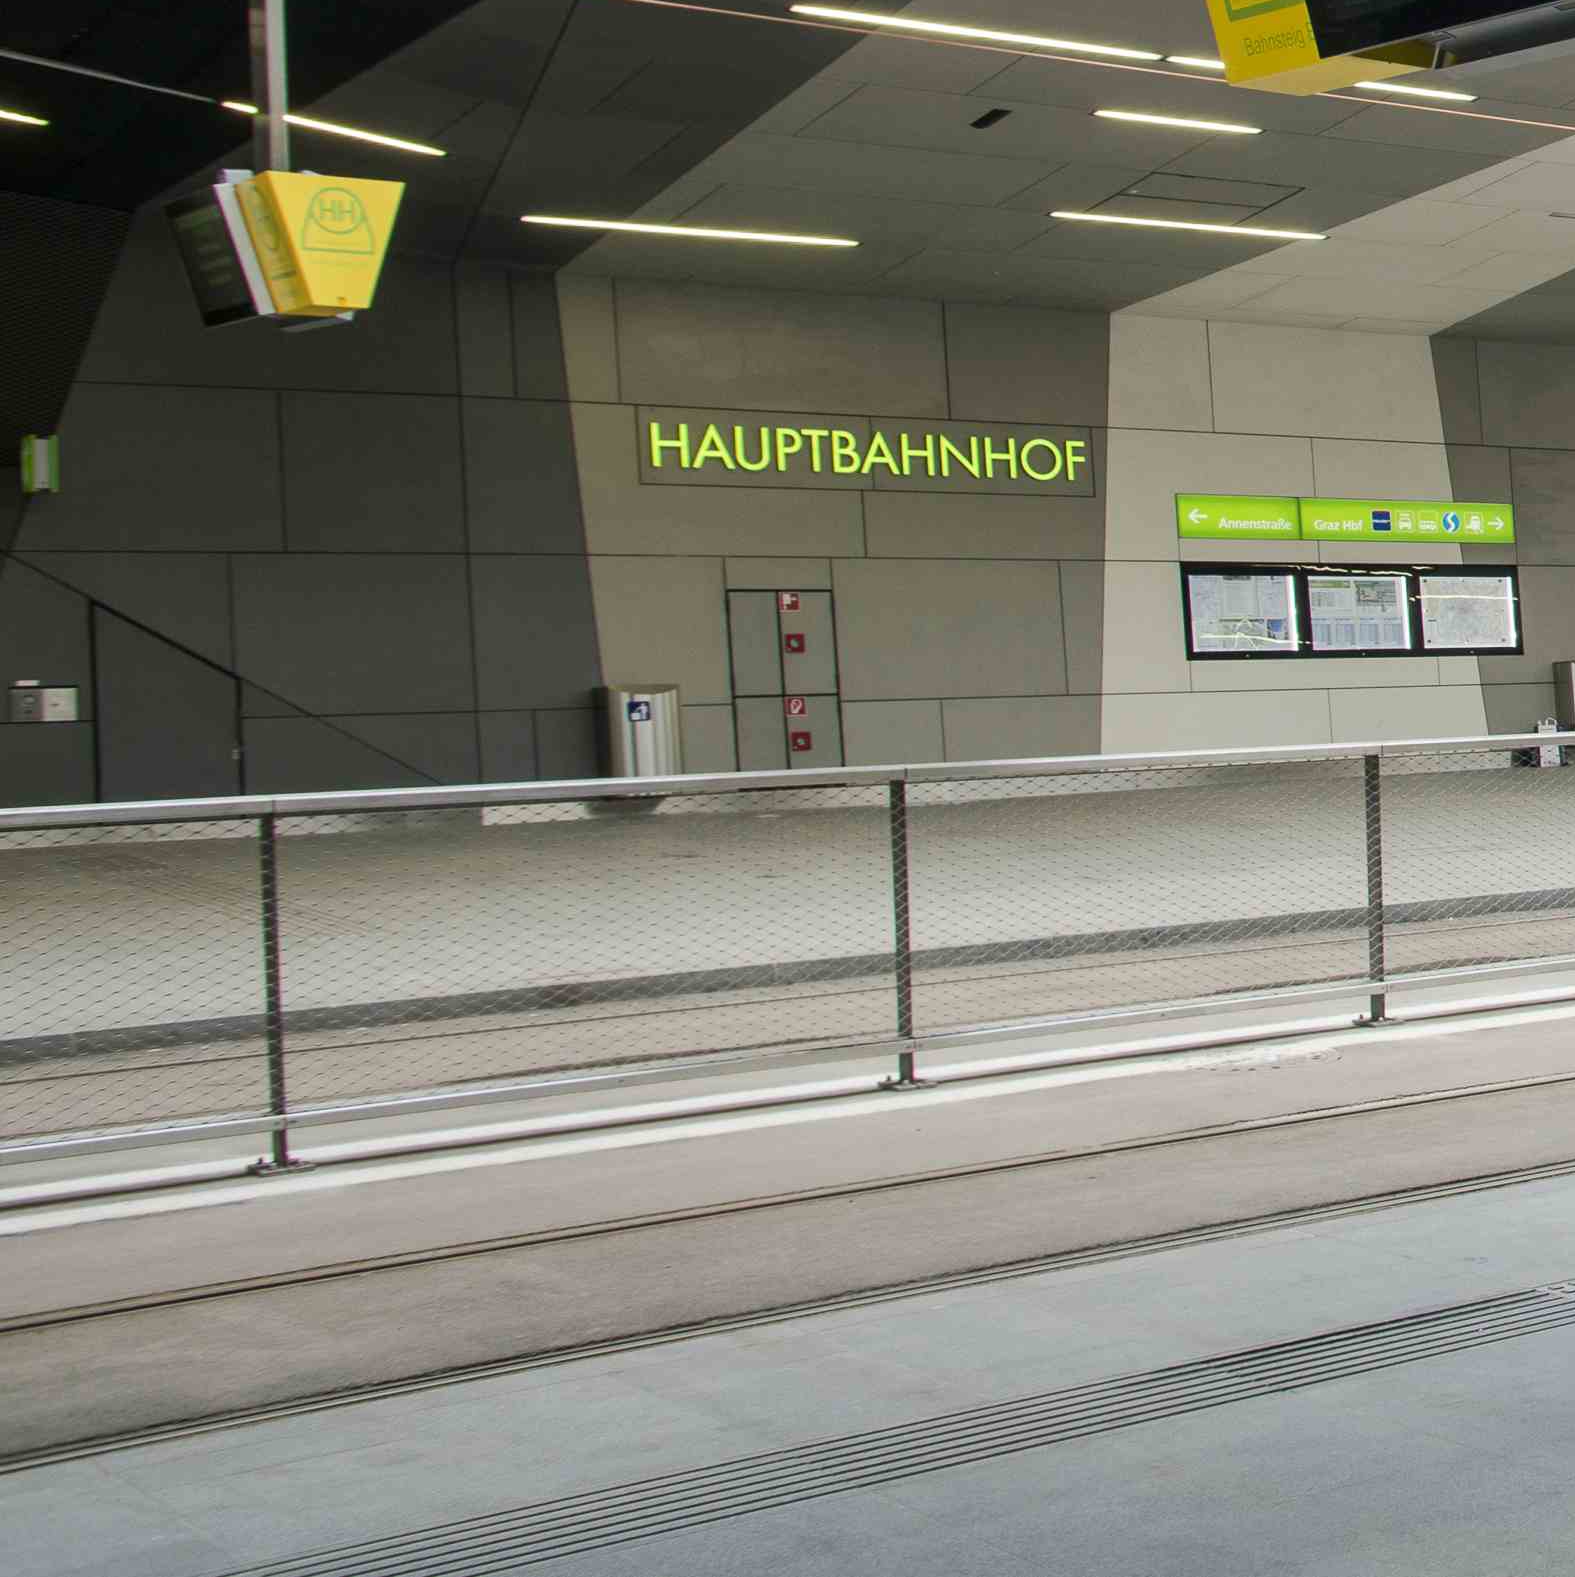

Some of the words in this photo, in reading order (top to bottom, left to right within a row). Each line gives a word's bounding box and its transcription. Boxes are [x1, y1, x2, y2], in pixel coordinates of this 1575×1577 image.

[650, 421, 1087, 481] HAUPTBAHNHOF
[1218, 516, 1292, 531] Annenstraße
[1313, 518, 1341, 531] Graz
[1342, 518, 1364, 532] Hbf
